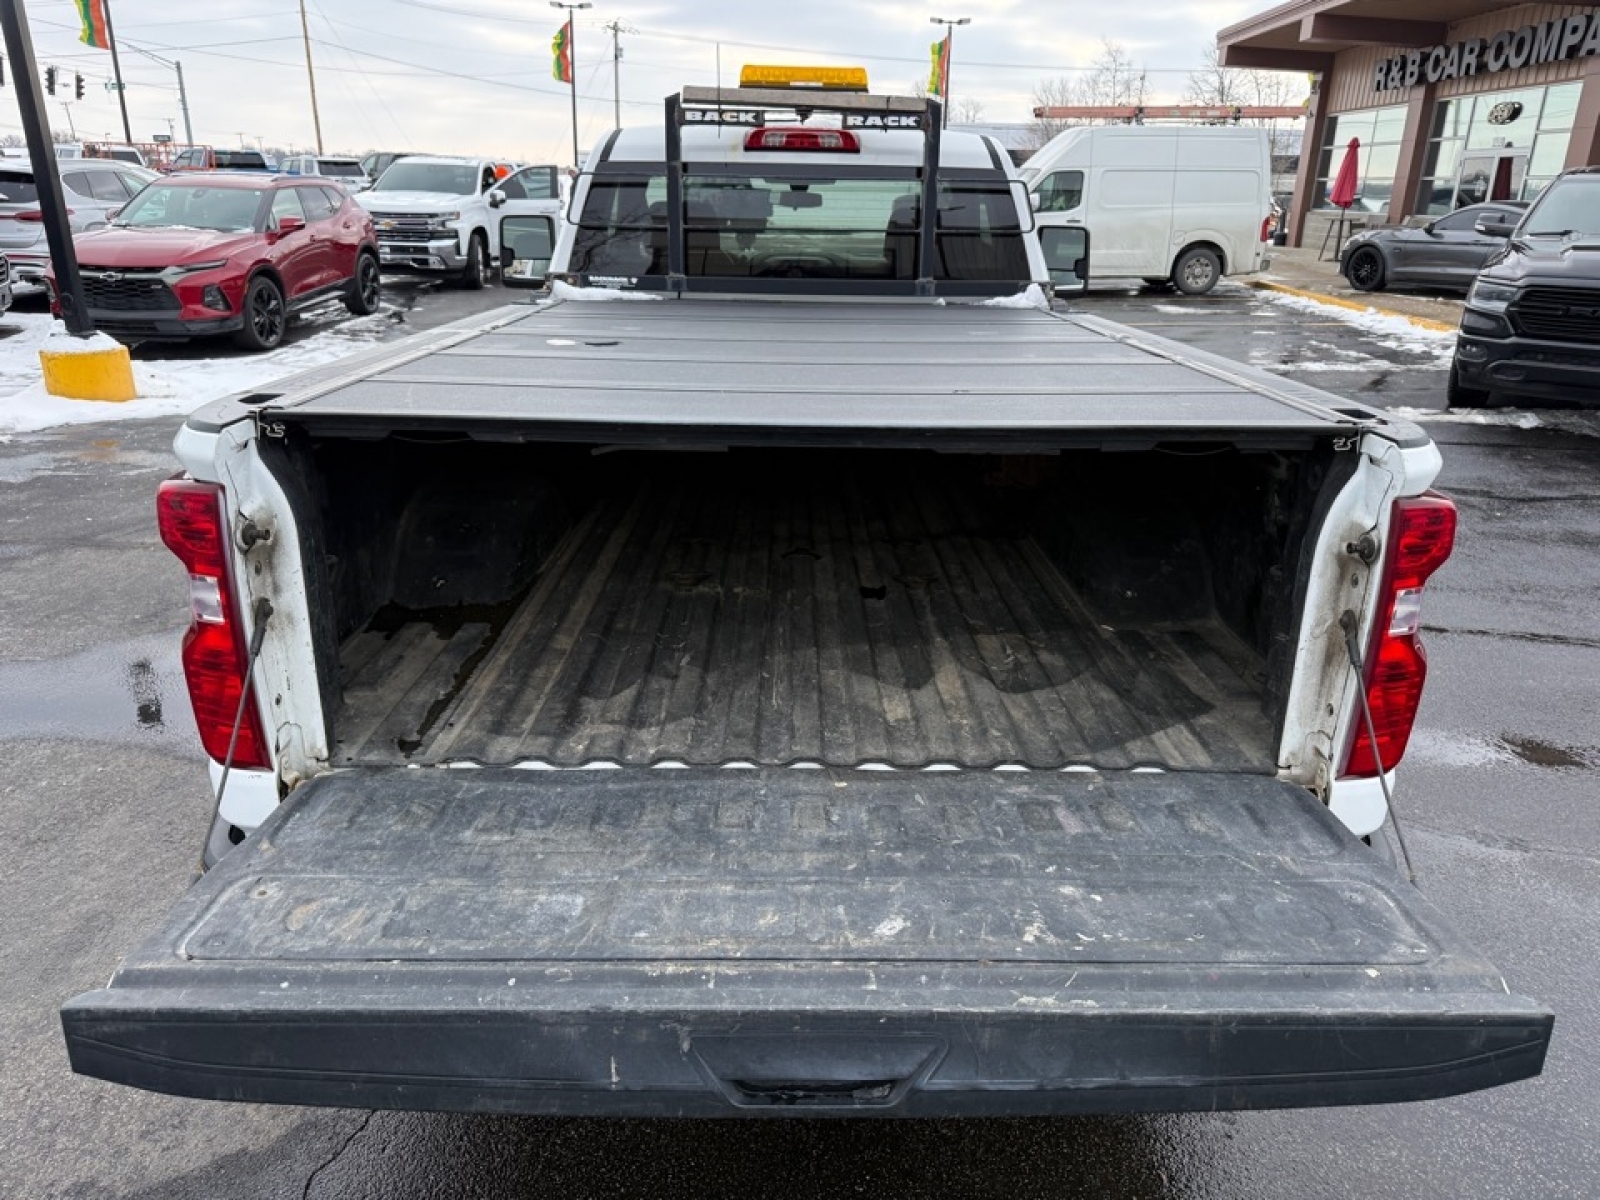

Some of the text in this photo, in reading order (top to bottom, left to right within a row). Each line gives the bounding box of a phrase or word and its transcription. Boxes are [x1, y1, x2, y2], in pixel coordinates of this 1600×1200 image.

[1374, 55, 1421, 91] R&B
[1426, 39, 1481, 83] CAR
[684, 111, 918, 126] BACK RACK
